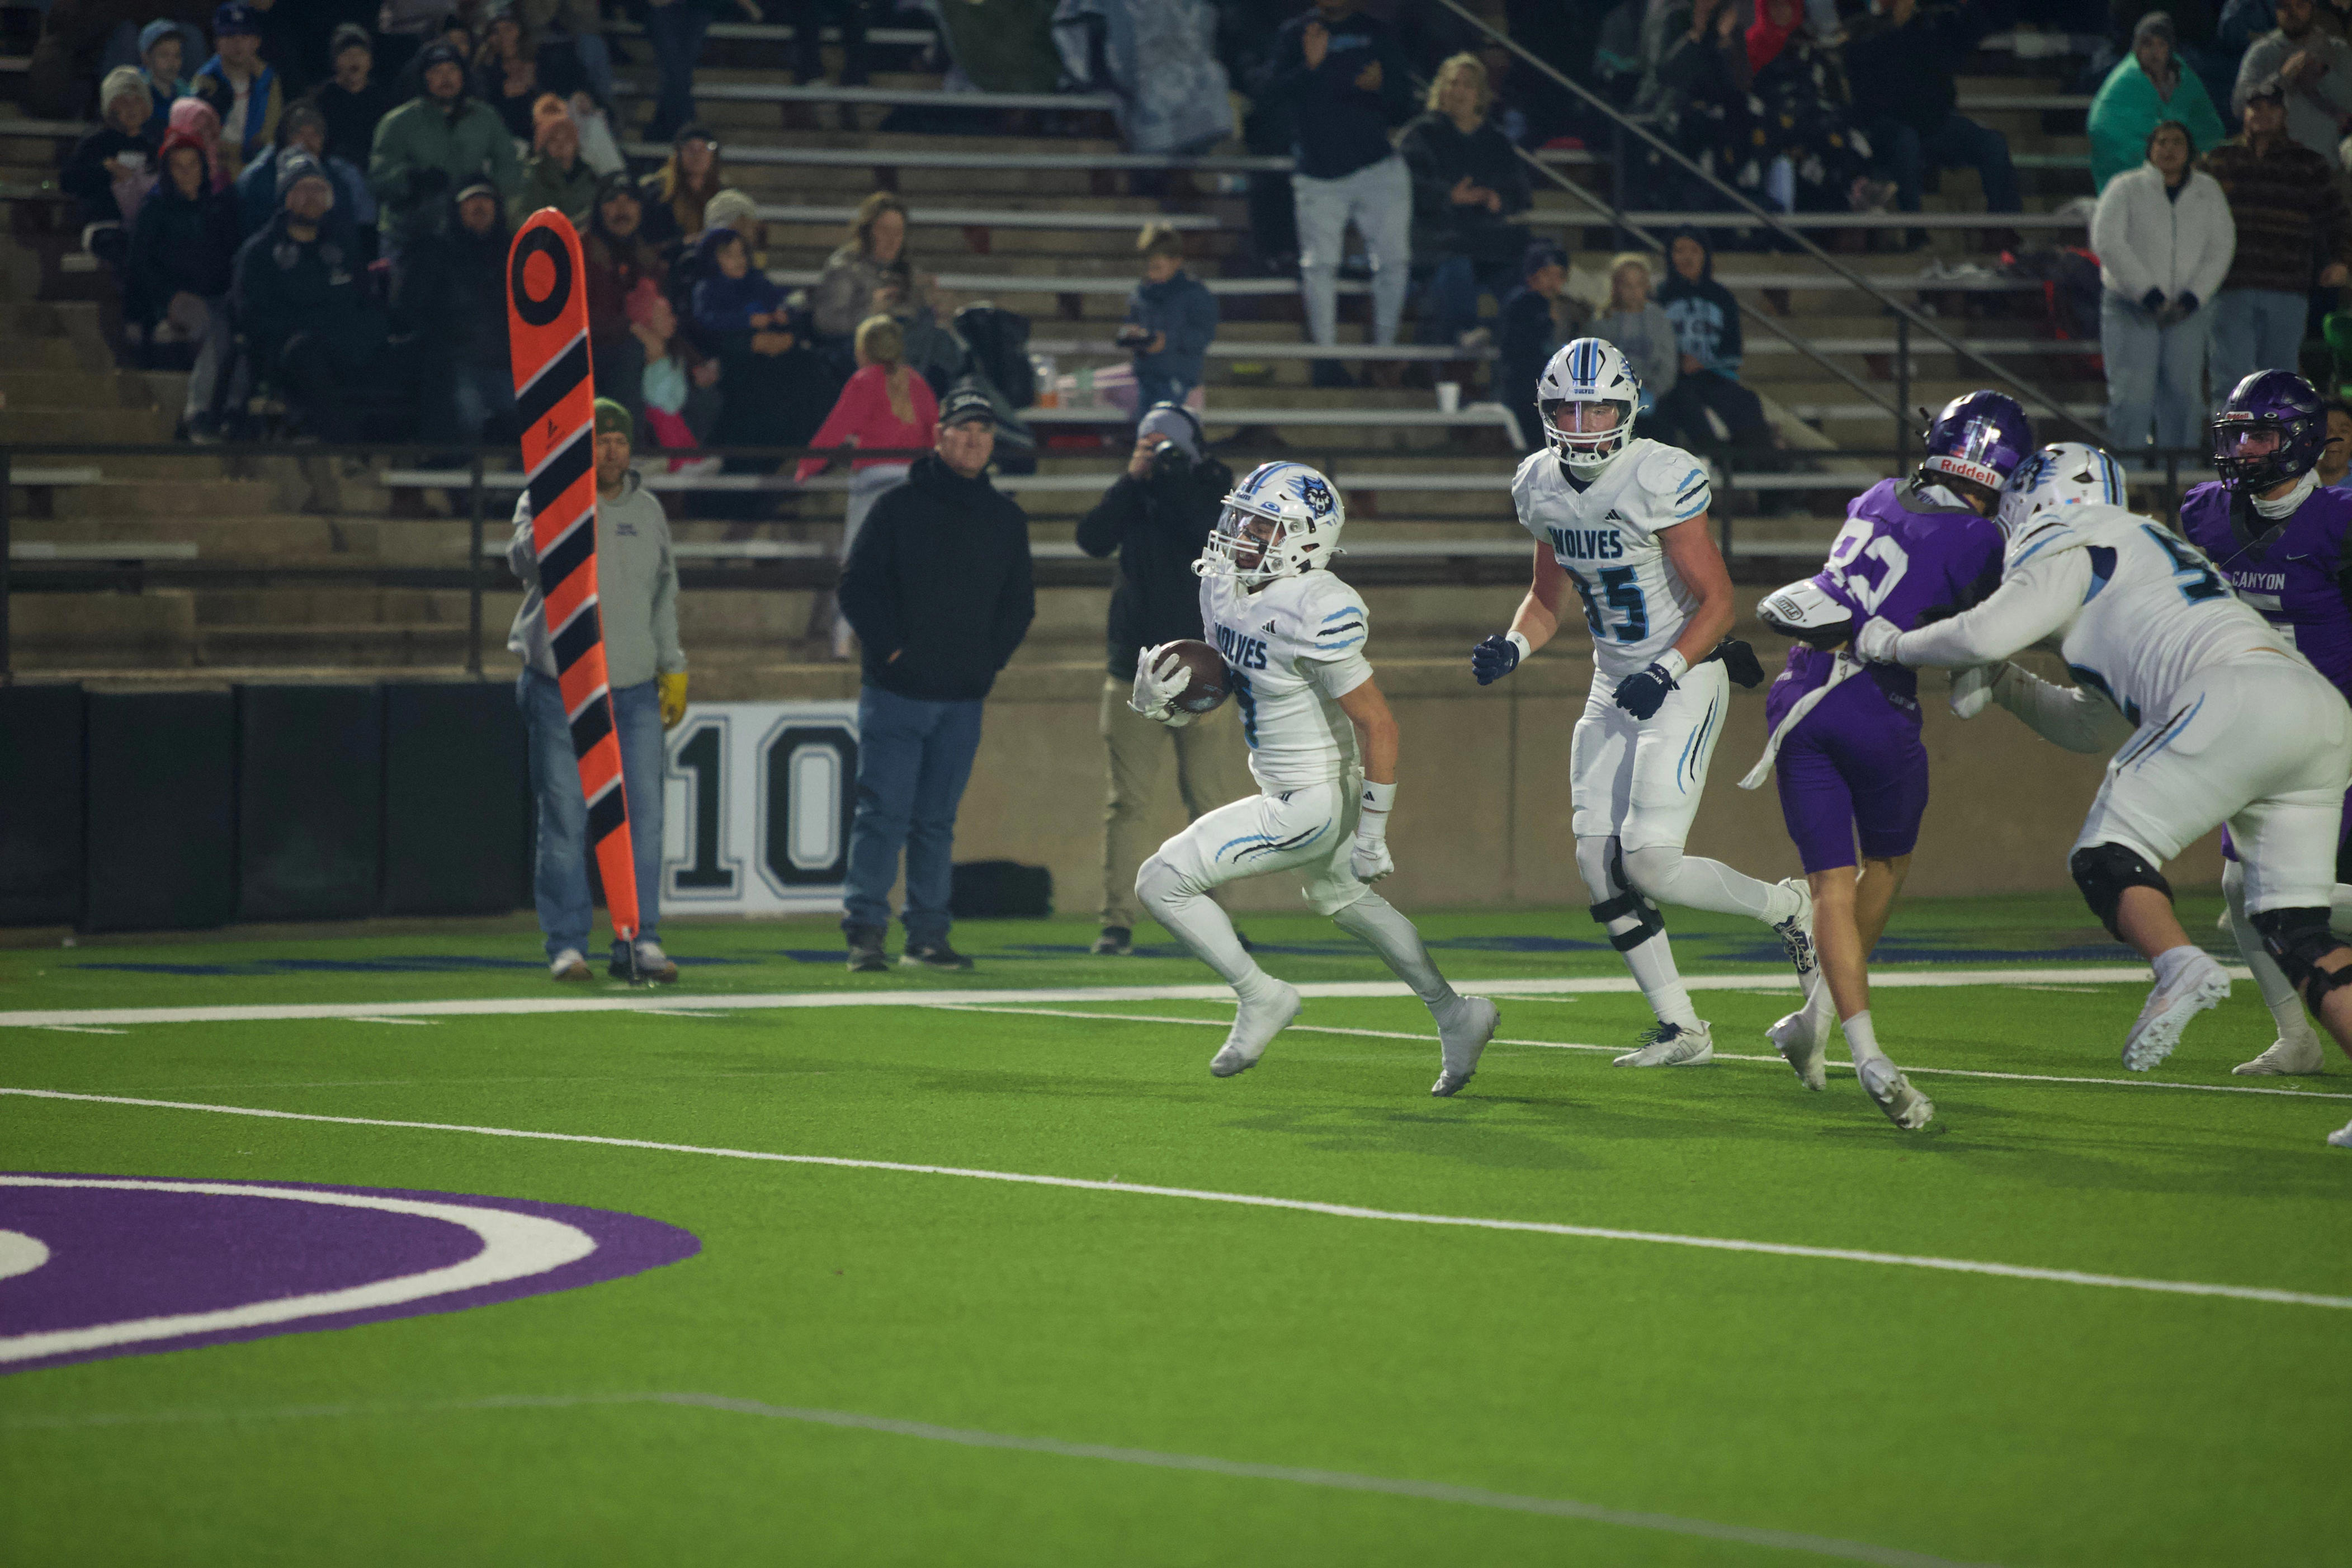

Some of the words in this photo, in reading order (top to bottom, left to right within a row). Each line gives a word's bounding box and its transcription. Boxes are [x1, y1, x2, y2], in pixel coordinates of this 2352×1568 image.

[1940, 459, 1996, 485] Riddell
[1547, 527, 1624, 560] WOLVES
[2232, 570, 2286, 590] CANYON
[664, 714, 859, 900] 10
